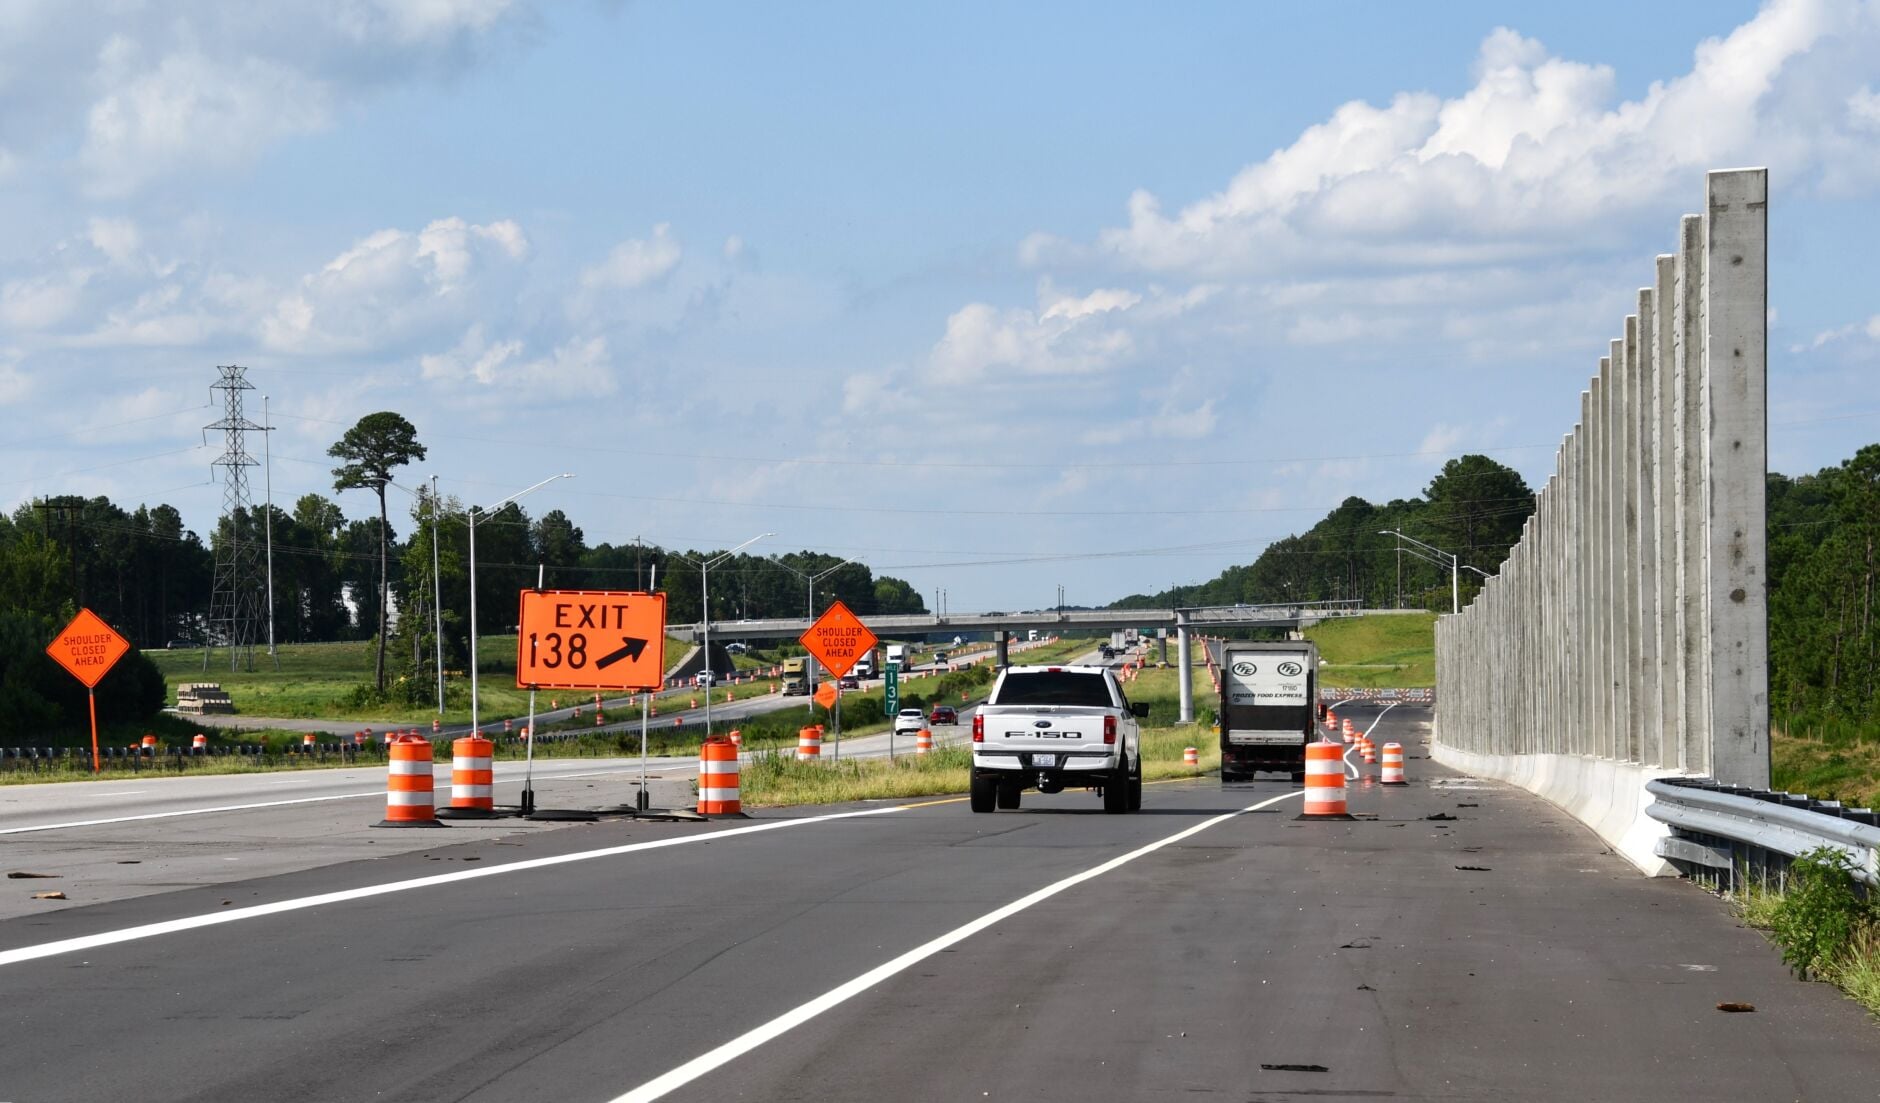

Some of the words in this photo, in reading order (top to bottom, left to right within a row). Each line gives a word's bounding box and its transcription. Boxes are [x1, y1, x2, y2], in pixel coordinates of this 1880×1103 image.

[555, 604, 628, 629] EXIT
[817, 628, 862, 636] SHOULDER
[64, 634, 111, 645] SHOULDER
[823, 638, 856, 646] CLOSED
[72, 645, 105, 655] CLOSED
[530, 632, 587, 669] 138
[75, 656, 104, 665] AHEAD
[888, 672, 896, 712] 137
[1004, 731, 1082, 739] F-150
